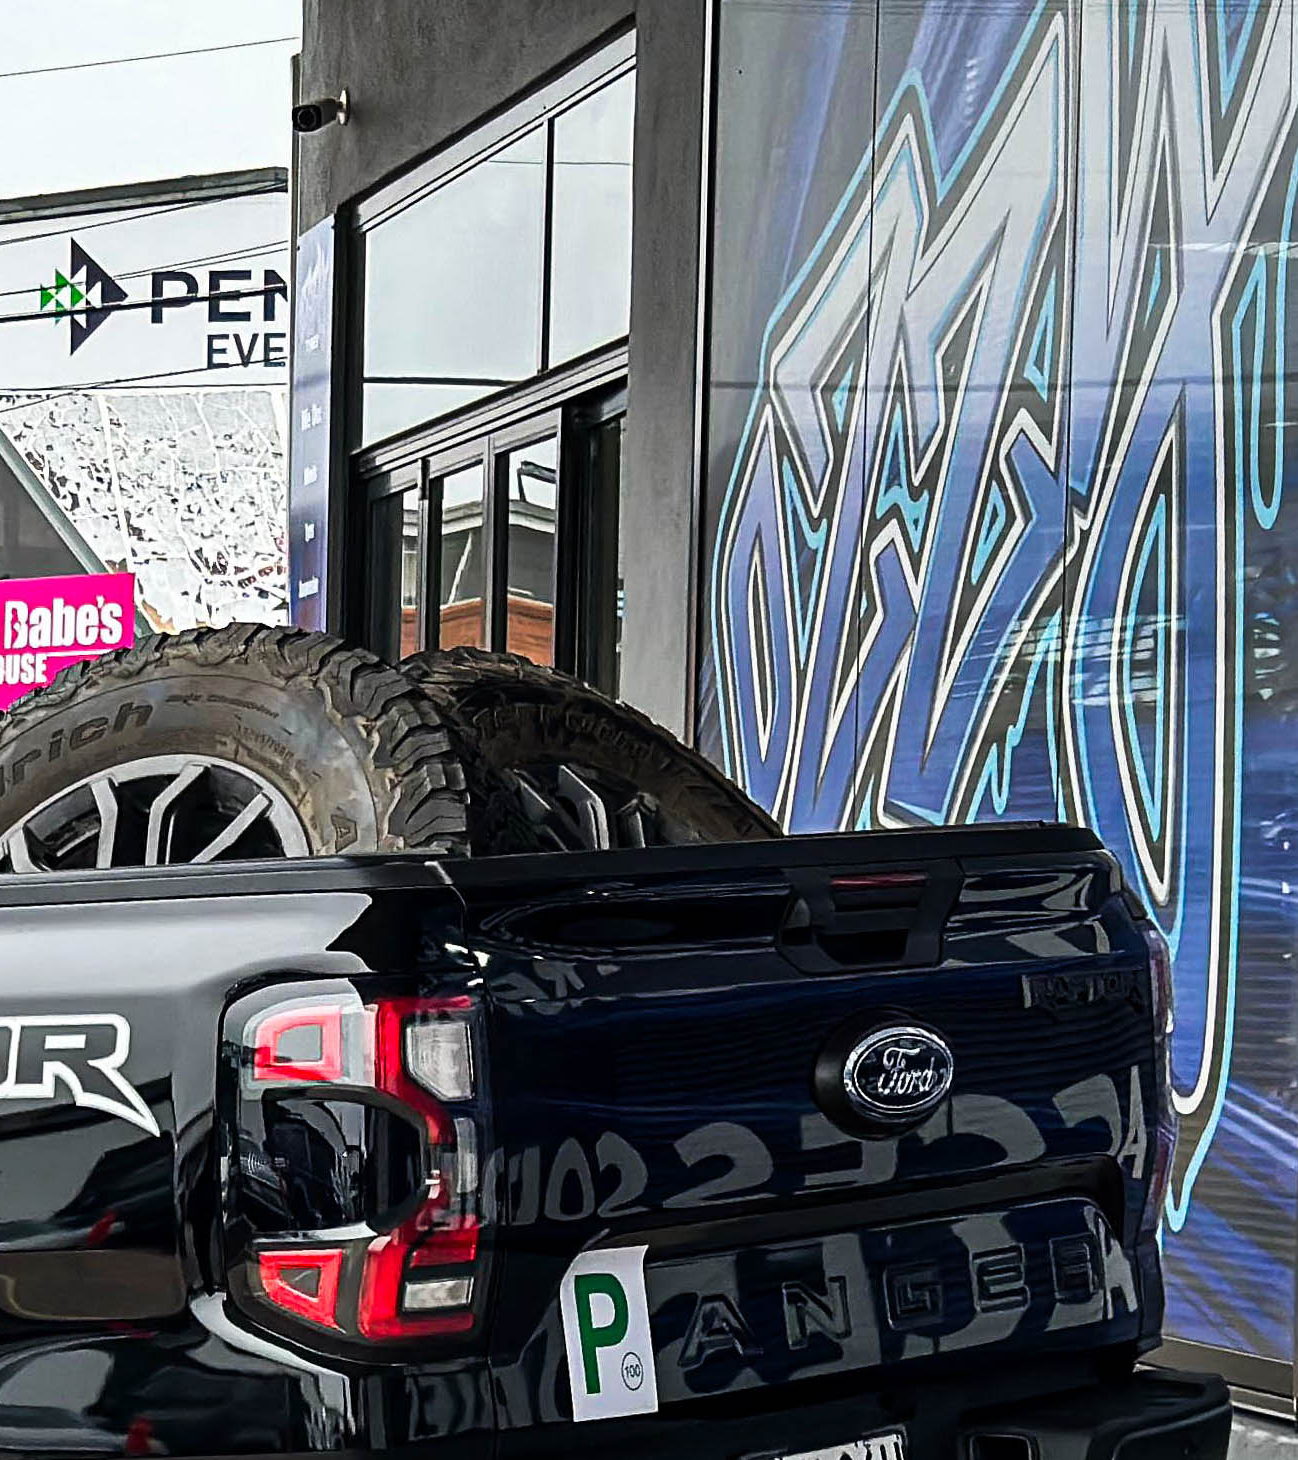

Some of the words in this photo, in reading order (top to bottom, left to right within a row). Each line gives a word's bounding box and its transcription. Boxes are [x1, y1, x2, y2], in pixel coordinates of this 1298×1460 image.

[207, 332, 286, 369] EVE
[4, 594, 123, 650] Babe's
[877, 1047, 938, 1095] Ford
[677, 1232, 1098, 1369] ANGER
[574, 1272, 629, 1395] P
[624, 1363, 641, 1379] 100
